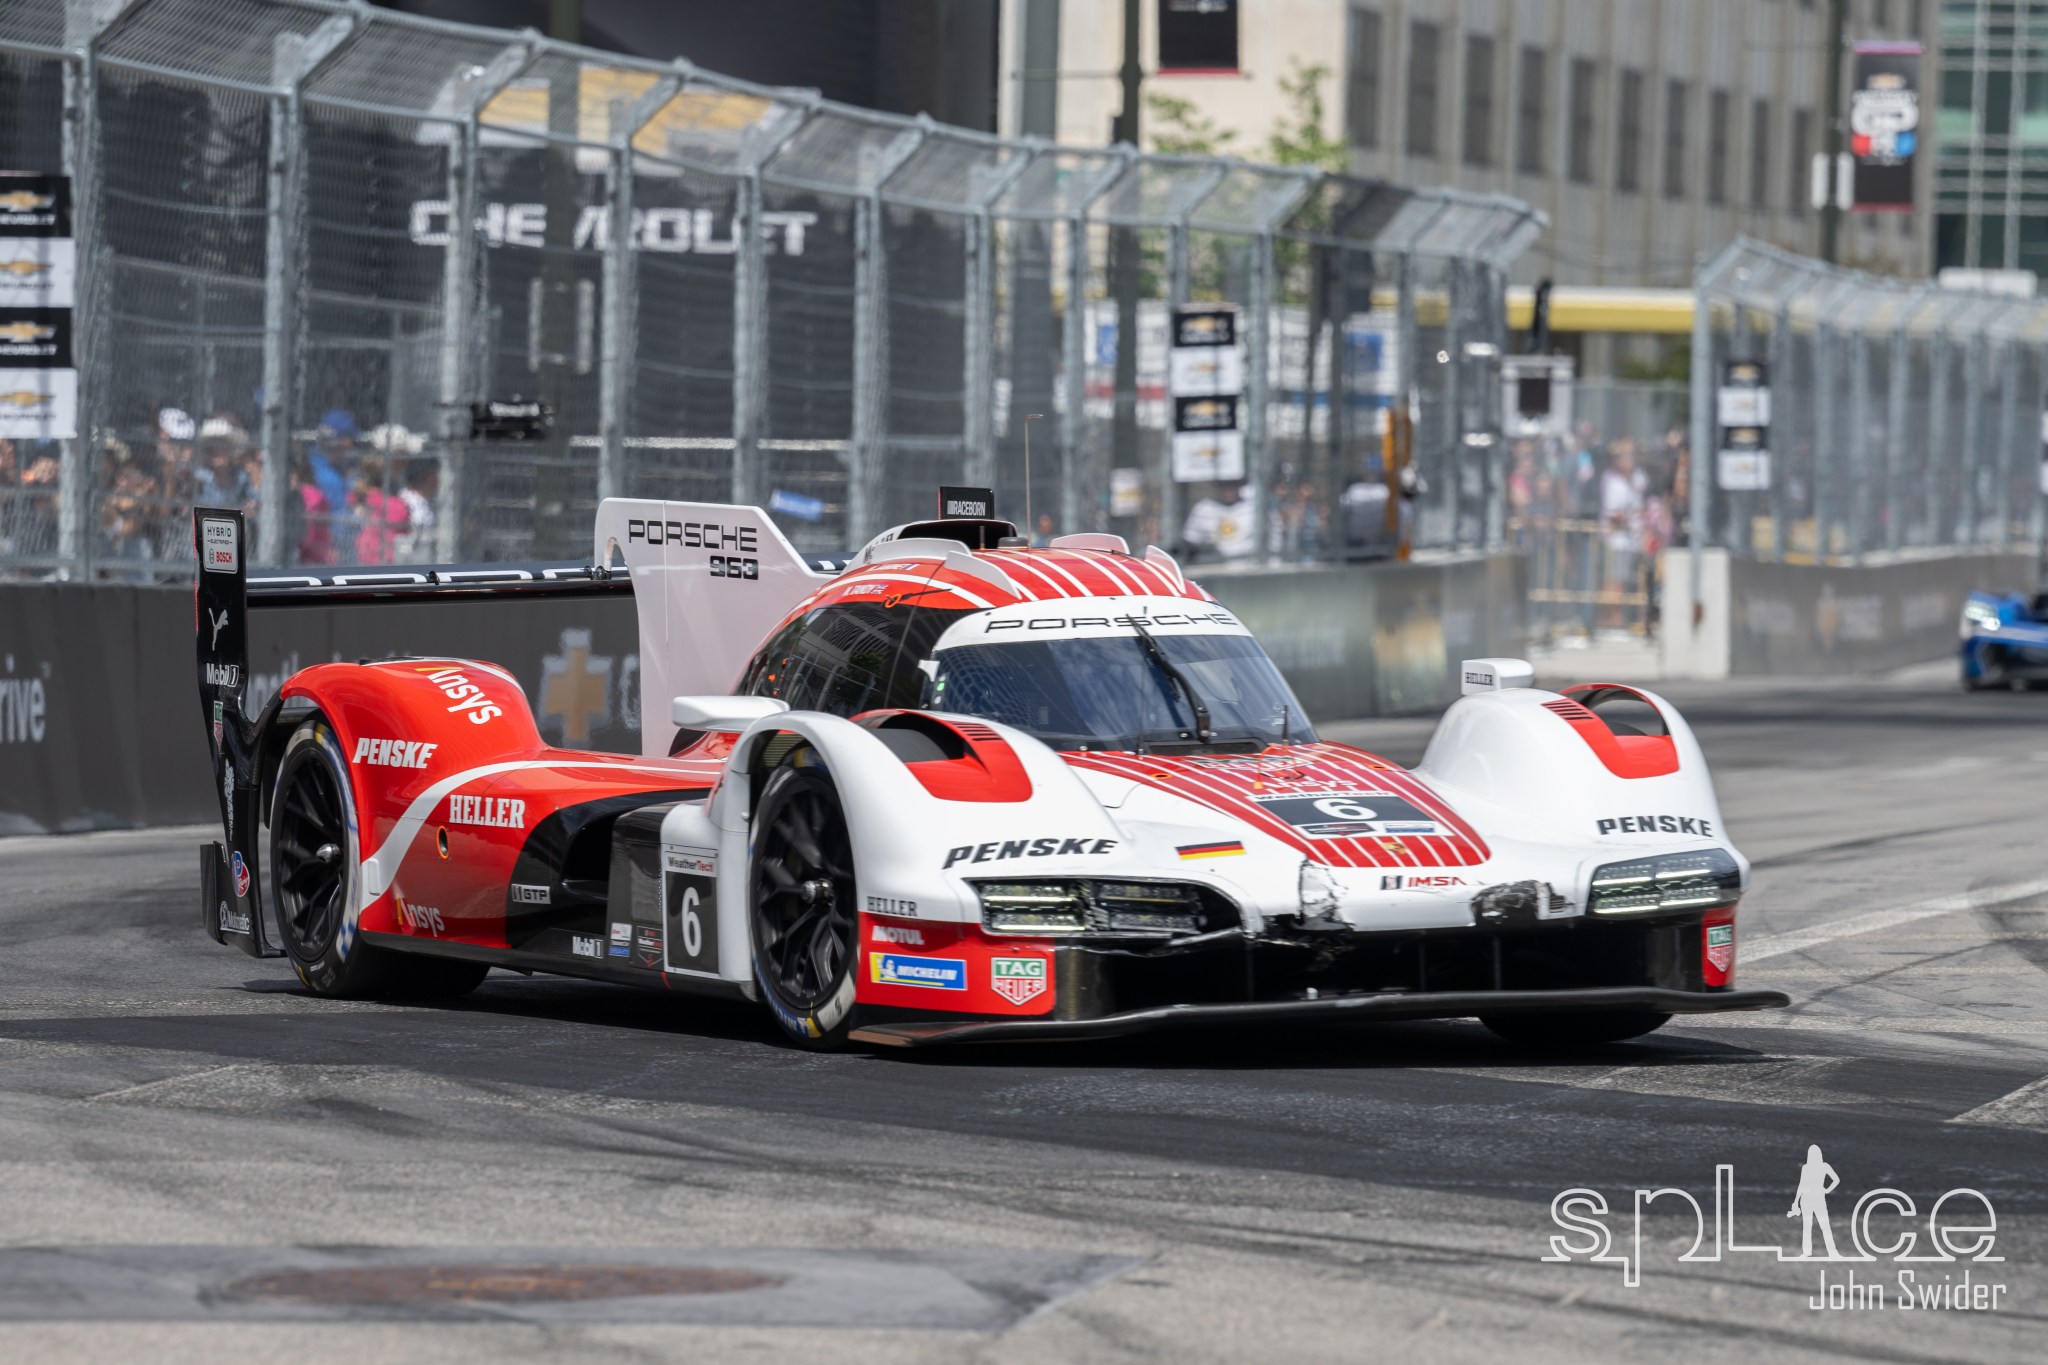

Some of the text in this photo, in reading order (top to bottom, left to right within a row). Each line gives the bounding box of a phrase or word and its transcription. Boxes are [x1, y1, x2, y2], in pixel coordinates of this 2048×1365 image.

[207, 526, 232, 538] HYBRID
[628, 519, 758, 553] PORSCHE
[215, 551, 233, 564] BOSCH
[709, 555, 759, 580] 963
[984, 612, 1239, 634] PORSCHE
[206, 663, 229, 686] Mobil
[1464, 671, 1494, 686] HELLER
[415, 667, 503, 725] Ansys
[352, 737, 439, 769] PENSKE
[449, 794, 526, 829] HELLER
[1312, 798, 1379, 821] 6
[1597, 815, 1714, 838] PENSKE
[668, 856, 714, 873] WeatherTech
[942, 838, 1118, 870] PENSKE
[523, 888, 548, 901] GTP
[866, 895, 918, 918] HELLER
[681, 886, 702, 957] 6
[572, 936, 595, 957] Mobil
[871, 925, 925, 946] MOTUL
[896, 965, 958, 981] MICHELIN
[997, 960, 1042, 977] TAG
[995, 979, 1043, 1002] HEUER
